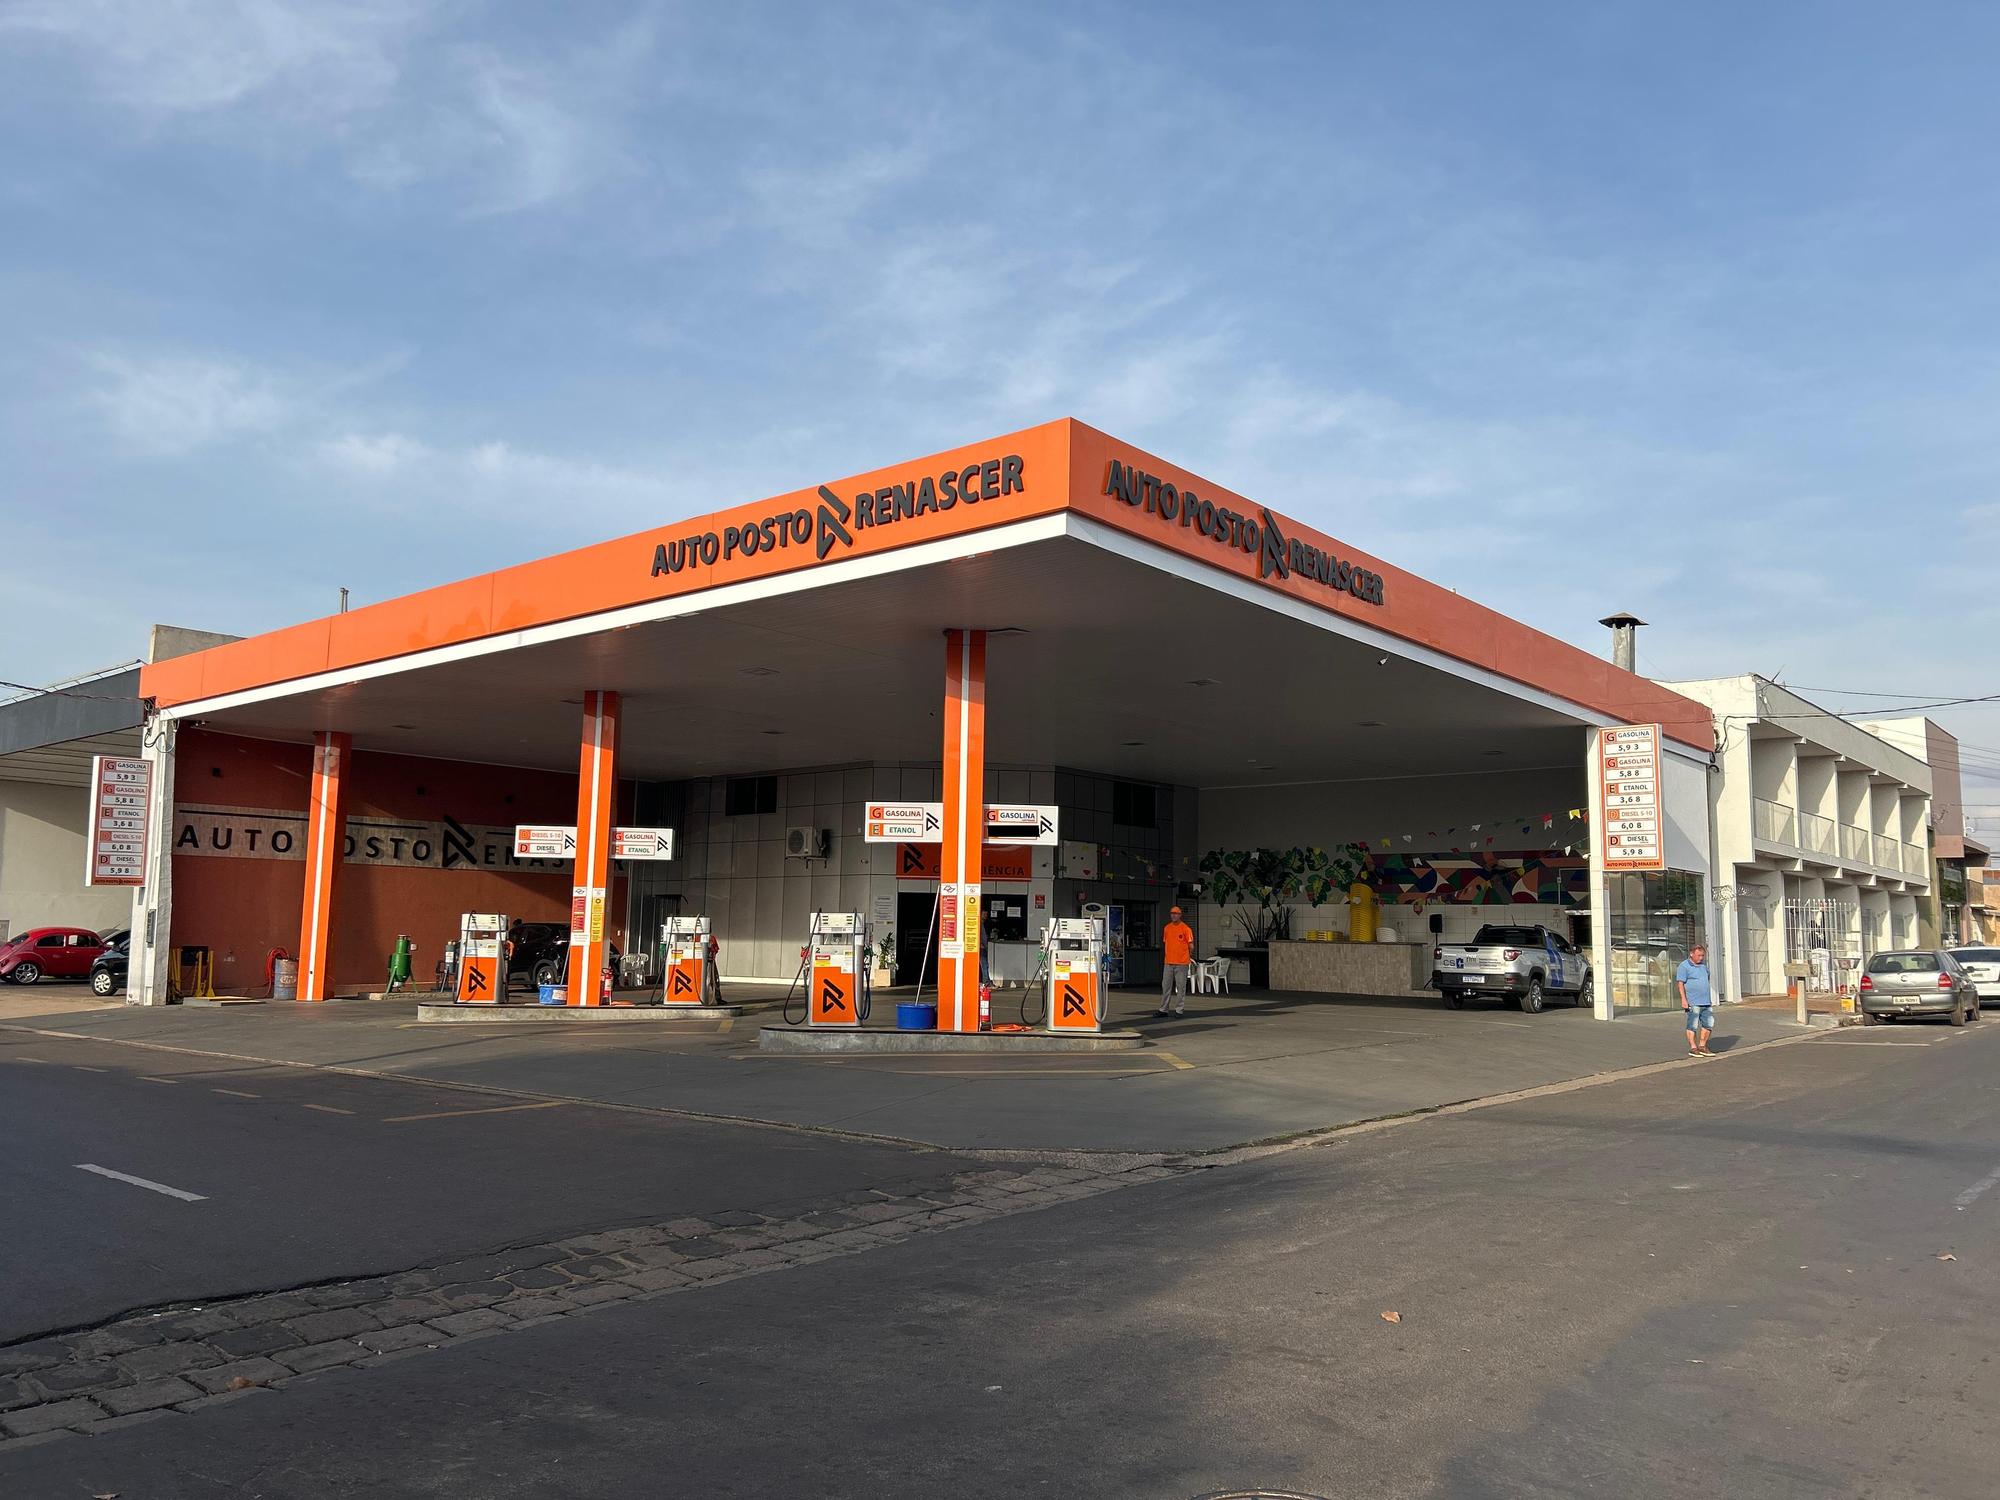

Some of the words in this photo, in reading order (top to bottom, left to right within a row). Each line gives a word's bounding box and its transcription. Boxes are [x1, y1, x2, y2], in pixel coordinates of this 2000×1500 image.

[651, 531, 719, 577] AUTO
[723, 509, 813, 561] POSTO
[854, 454, 1025, 530] RENASCER
[1105, 459, 1180, 520] AUTO
[1181, 491, 1260, 553] POSTO
[1288, 537, 1384, 606] RENASCER
[176, 824, 293, 853] AUTO
